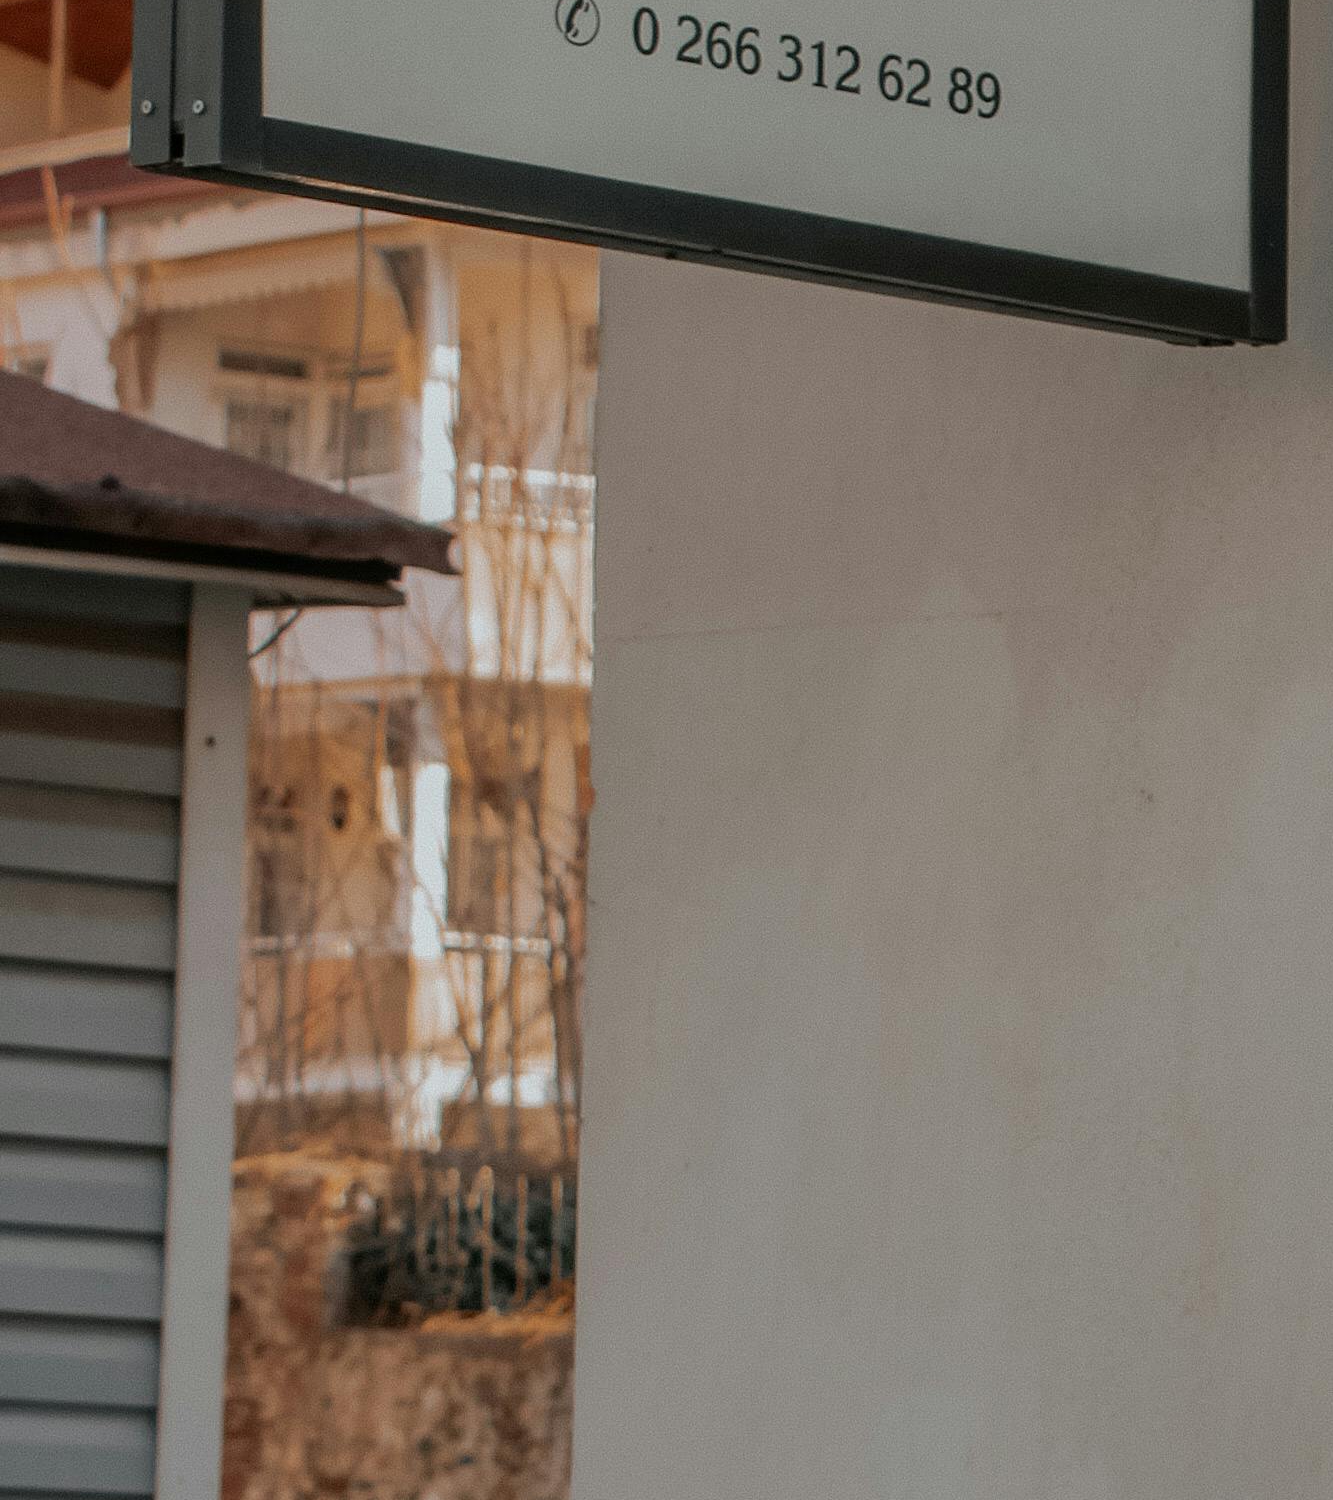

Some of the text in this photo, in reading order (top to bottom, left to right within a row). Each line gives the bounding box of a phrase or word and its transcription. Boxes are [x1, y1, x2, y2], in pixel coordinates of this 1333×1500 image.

[632, 9, 1003, 121] 0 266 312 62 89
